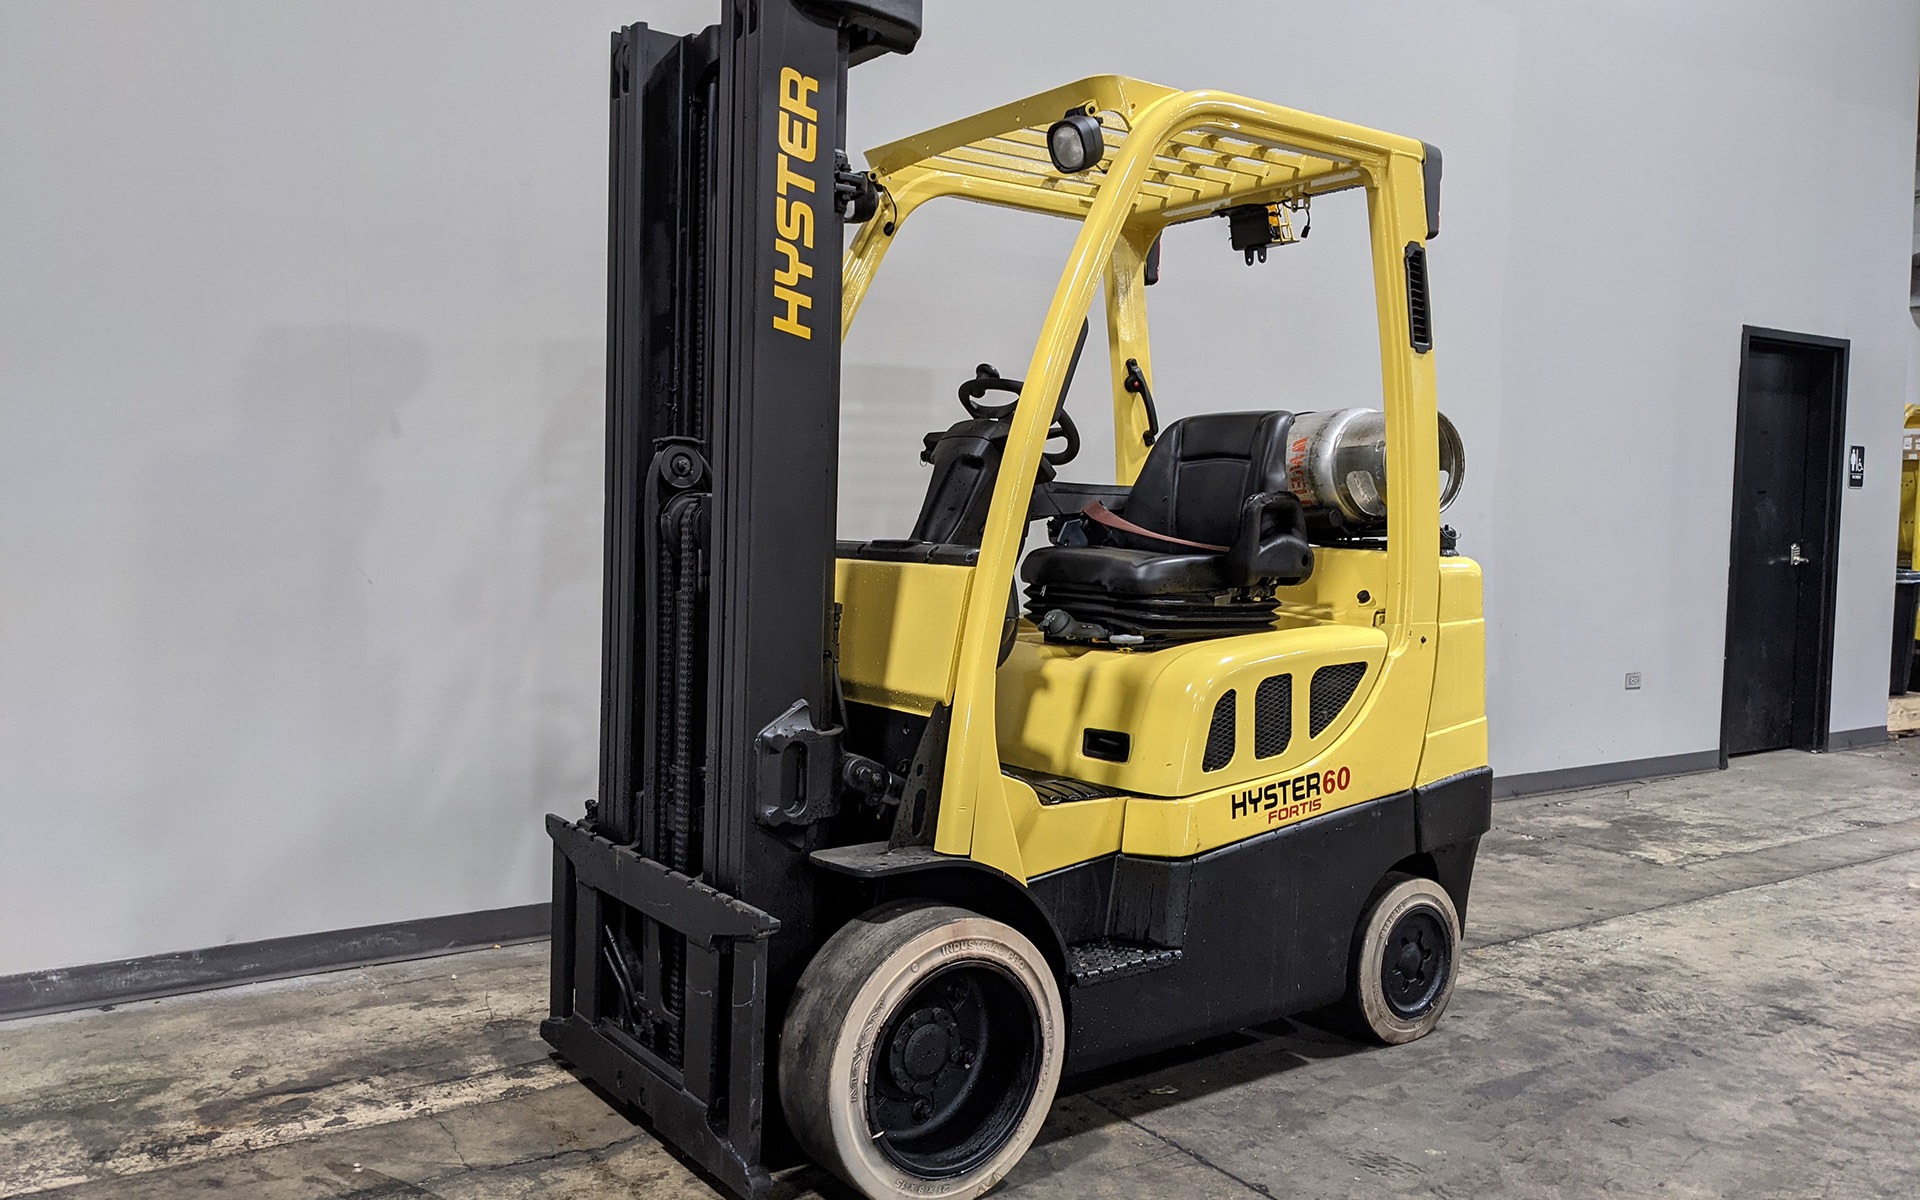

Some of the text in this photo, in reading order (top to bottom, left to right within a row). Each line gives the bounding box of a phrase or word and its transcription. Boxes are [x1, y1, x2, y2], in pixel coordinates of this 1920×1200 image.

[773, 66, 819, 340] HYSTER
[1231, 766, 1351, 820] HYSTER 60
[1267, 798, 1322, 824] FORTIS
[941, 940, 1026, 971] INDUSTRIAL PRO
[894, 1179, 907, 1190] 15
[917, 1185, 925, 1195] 8
[937, 1183, 950, 1194] 21
